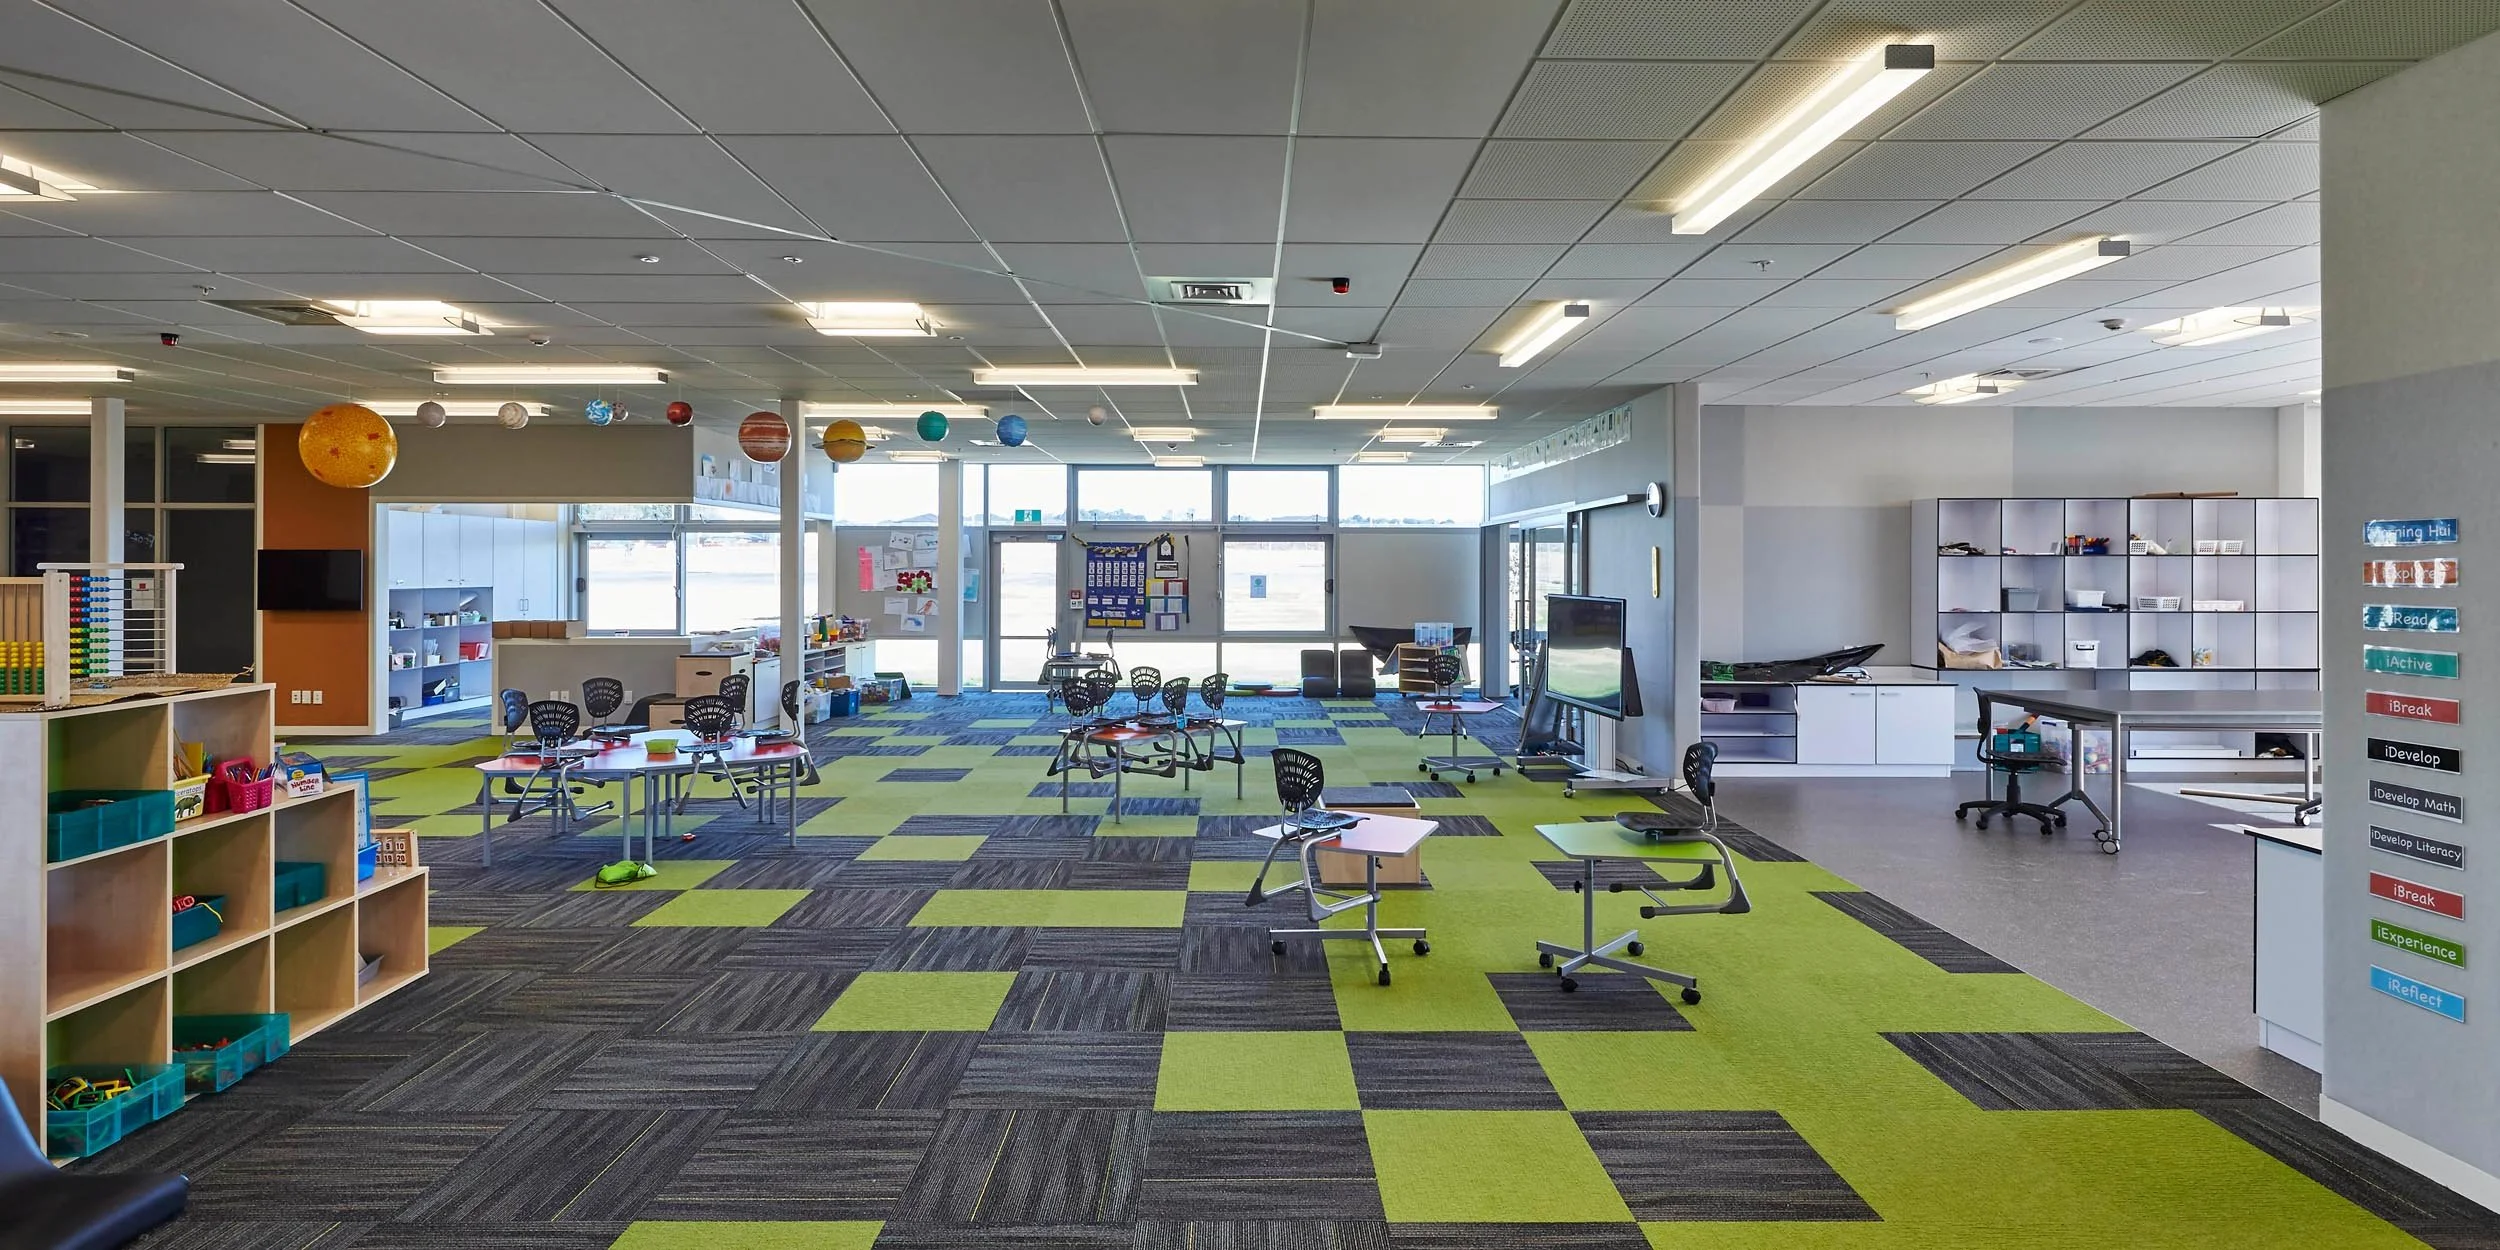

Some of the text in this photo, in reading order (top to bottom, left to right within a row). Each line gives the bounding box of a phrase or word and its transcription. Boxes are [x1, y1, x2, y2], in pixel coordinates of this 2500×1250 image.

[2390, 611, 2428, 626] Read
[2386, 655, 2433, 671] iActive
[2389, 699, 2433, 717] iBreak
[2385, 745, 2441, 769] iDevelop
[2374, 787, 2456, 815] iDevelop Math
[396, 842, 404, 850] 10
[2371, 829, 2462, 862] iDevelop Literacy
[396, 854, 405, 862] 20
[2393, 883, 2436, 907] iBreak
[2377, 926, 2457, 961] iExperience
[2388, 977, 2443, 1009] iReflect
